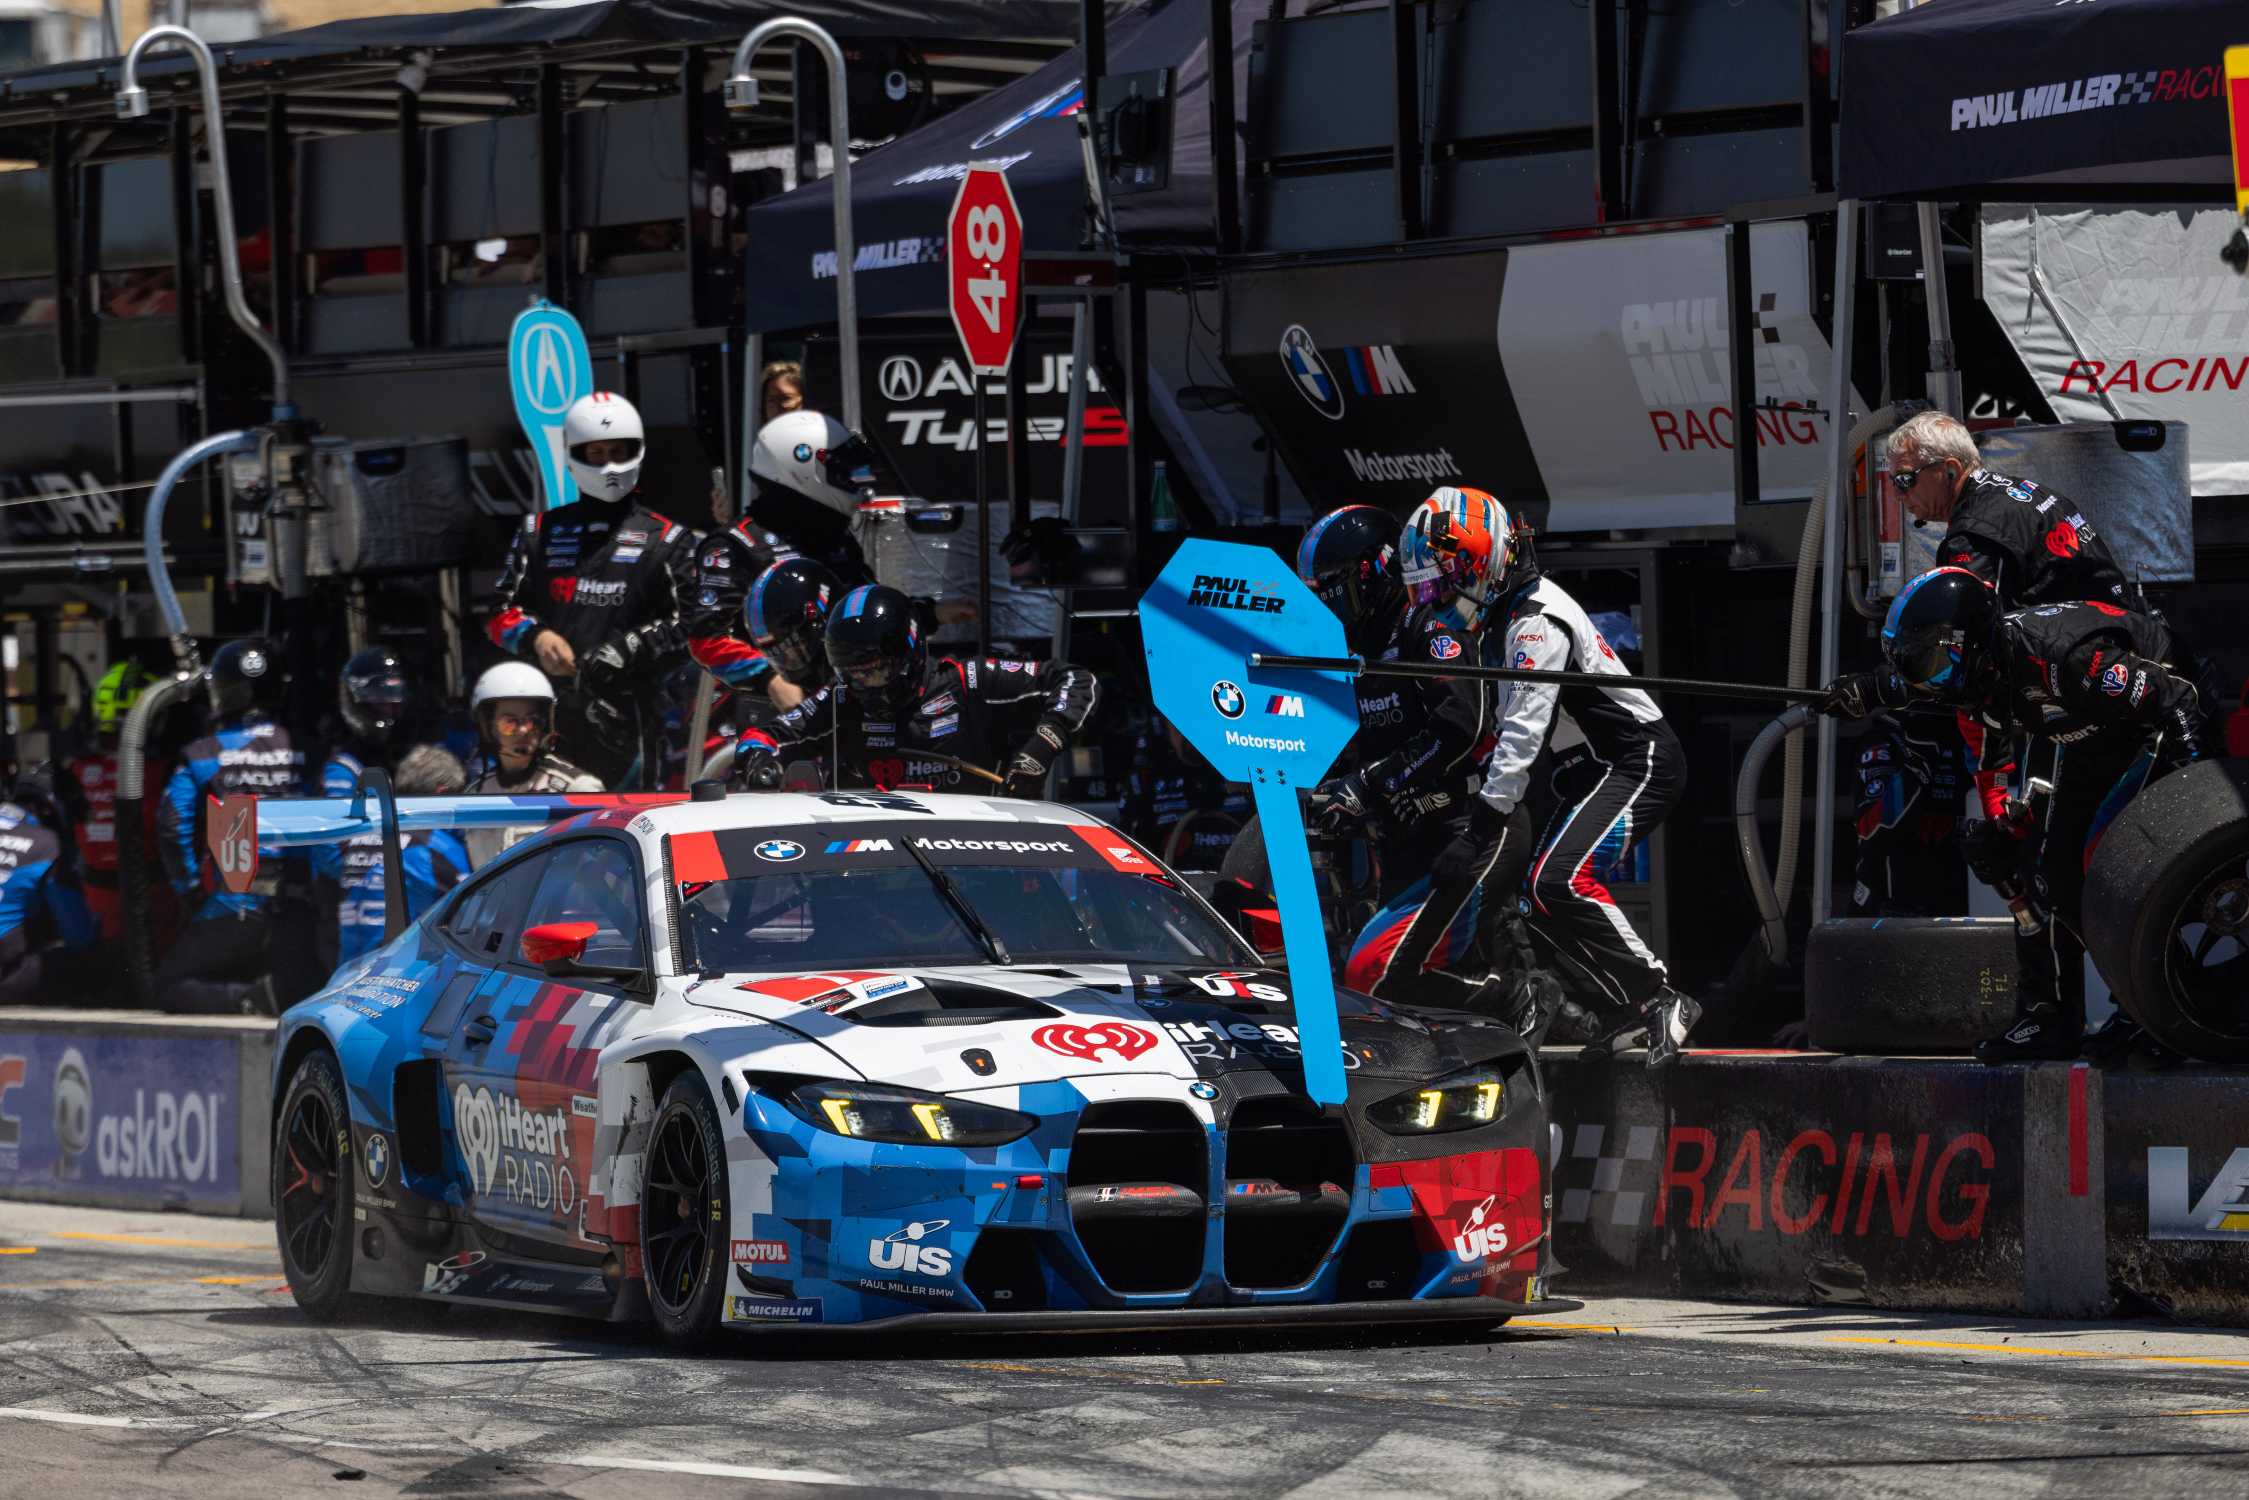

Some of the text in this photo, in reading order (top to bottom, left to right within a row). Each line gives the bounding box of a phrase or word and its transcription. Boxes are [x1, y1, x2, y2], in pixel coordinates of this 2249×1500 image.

[1951, 64, 2227, 131] PAUL MILLER RACI
[966, 203, 1007, 333] 48
[2058, 355, 2249, 394] RACIN
[1648, 401, 1819, 452] RACNG
[1344, 446, 1462, 485] Motorsport
[1187, 589, 1285, 614] MILLER
[1193, 575, 1251, 595] PAUL
[1358, 691, 1401, 714] Heart
[1225, 730, 1307, 753] Motorsport
[912, 836, 1074, 855] Motorsport
[1162, 1021, 1301, 1044] iHea
[1180, 1042, 1361, 1070] RADO
[97, 1088, 218, 1183] askROI
[498, 1092, 570, 1159] iHeart
[503, 1154, 576, 1215] RADIO
[1652, 1126, 1997, 1241] RACING
[734, 1243, 787, 1261] MOTUL
[868, 1239, 953, 1277] UIS
[1453, 1223, 1508, 1263] UIS
[860, 1279, 954, 1297] PAUL MILLER BMW
[1471, 1264, 1496, 1280] MILLER
[748, 1304, 814, 1317] MICHELIN
